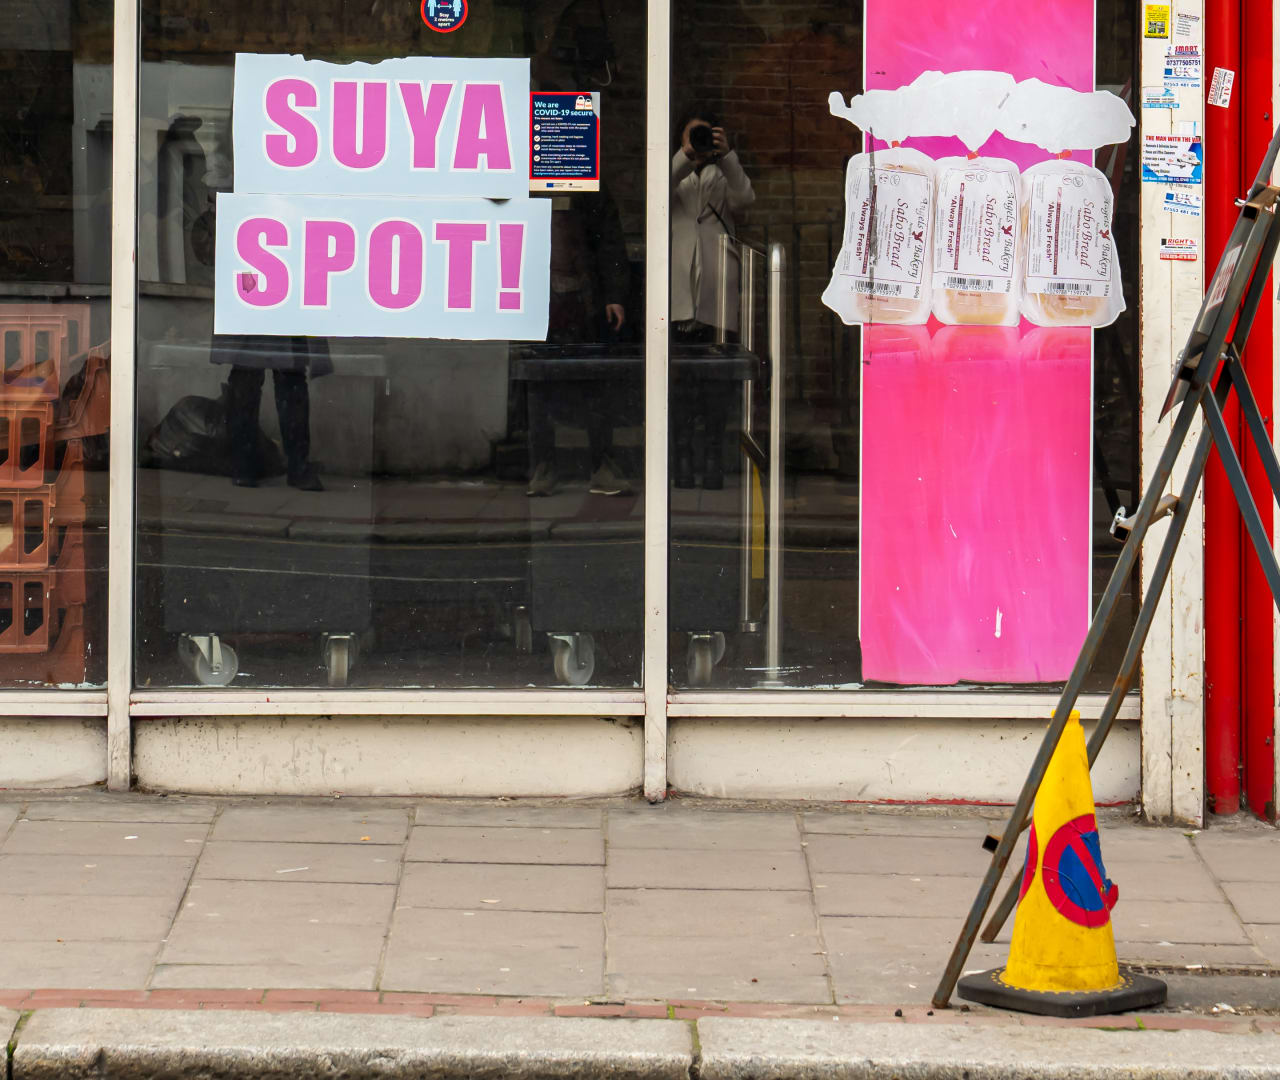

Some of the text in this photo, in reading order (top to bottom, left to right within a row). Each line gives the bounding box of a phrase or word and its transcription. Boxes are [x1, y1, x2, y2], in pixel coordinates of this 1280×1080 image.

[263, 77, 515, 171] SUYA
[891, 231, 905, 270] Bread
[894, 198, 908, 233] Sabo
[982, 194, 997, 265] Sabo Bread
[999, 191, 1015, 272] Angels Bakery
[1080, 199, 1094, 269] Sabo Bread
[234, 216, 526, 312] SPOT!
[908, 243, 923, 278] Bakery
[1097, 243, 1110, 277] Bakery
